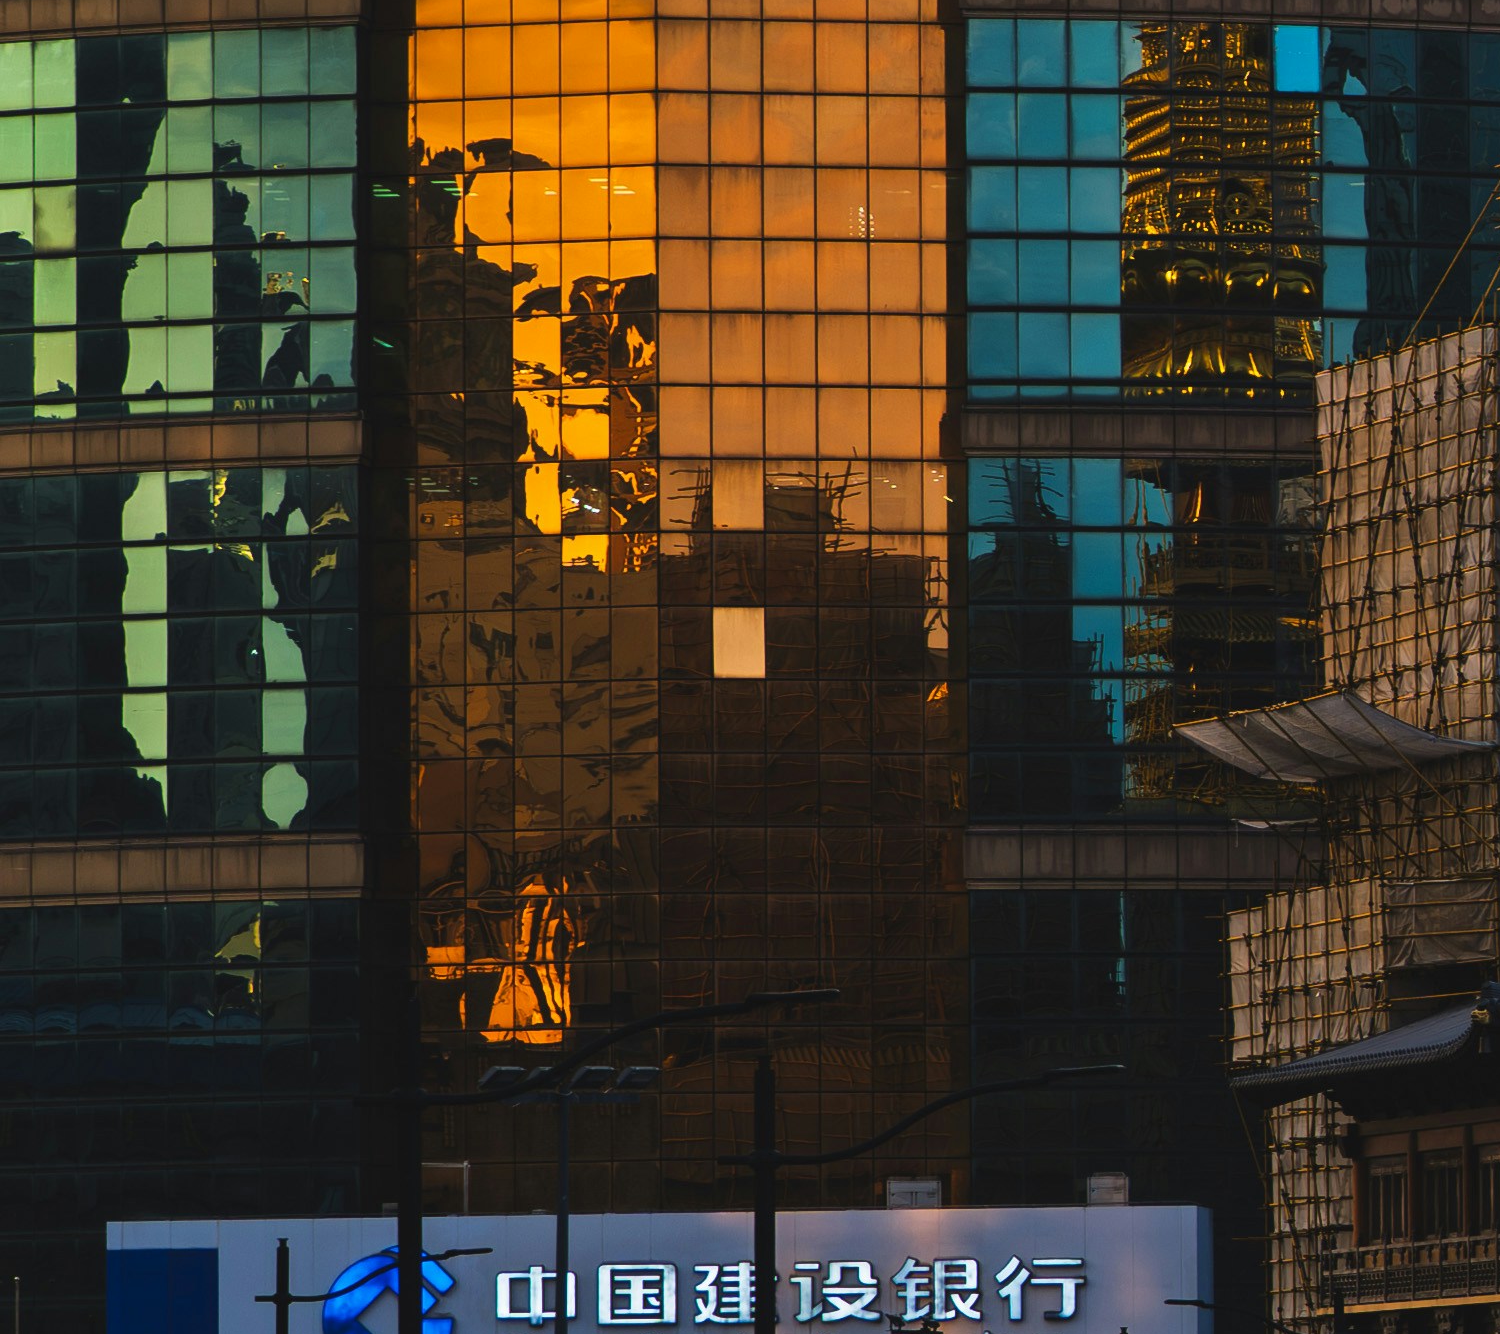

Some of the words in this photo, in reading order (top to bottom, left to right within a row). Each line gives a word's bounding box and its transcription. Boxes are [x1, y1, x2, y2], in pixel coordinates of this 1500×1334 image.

[496, 1255, 1086, 1327] 中国建设银行
